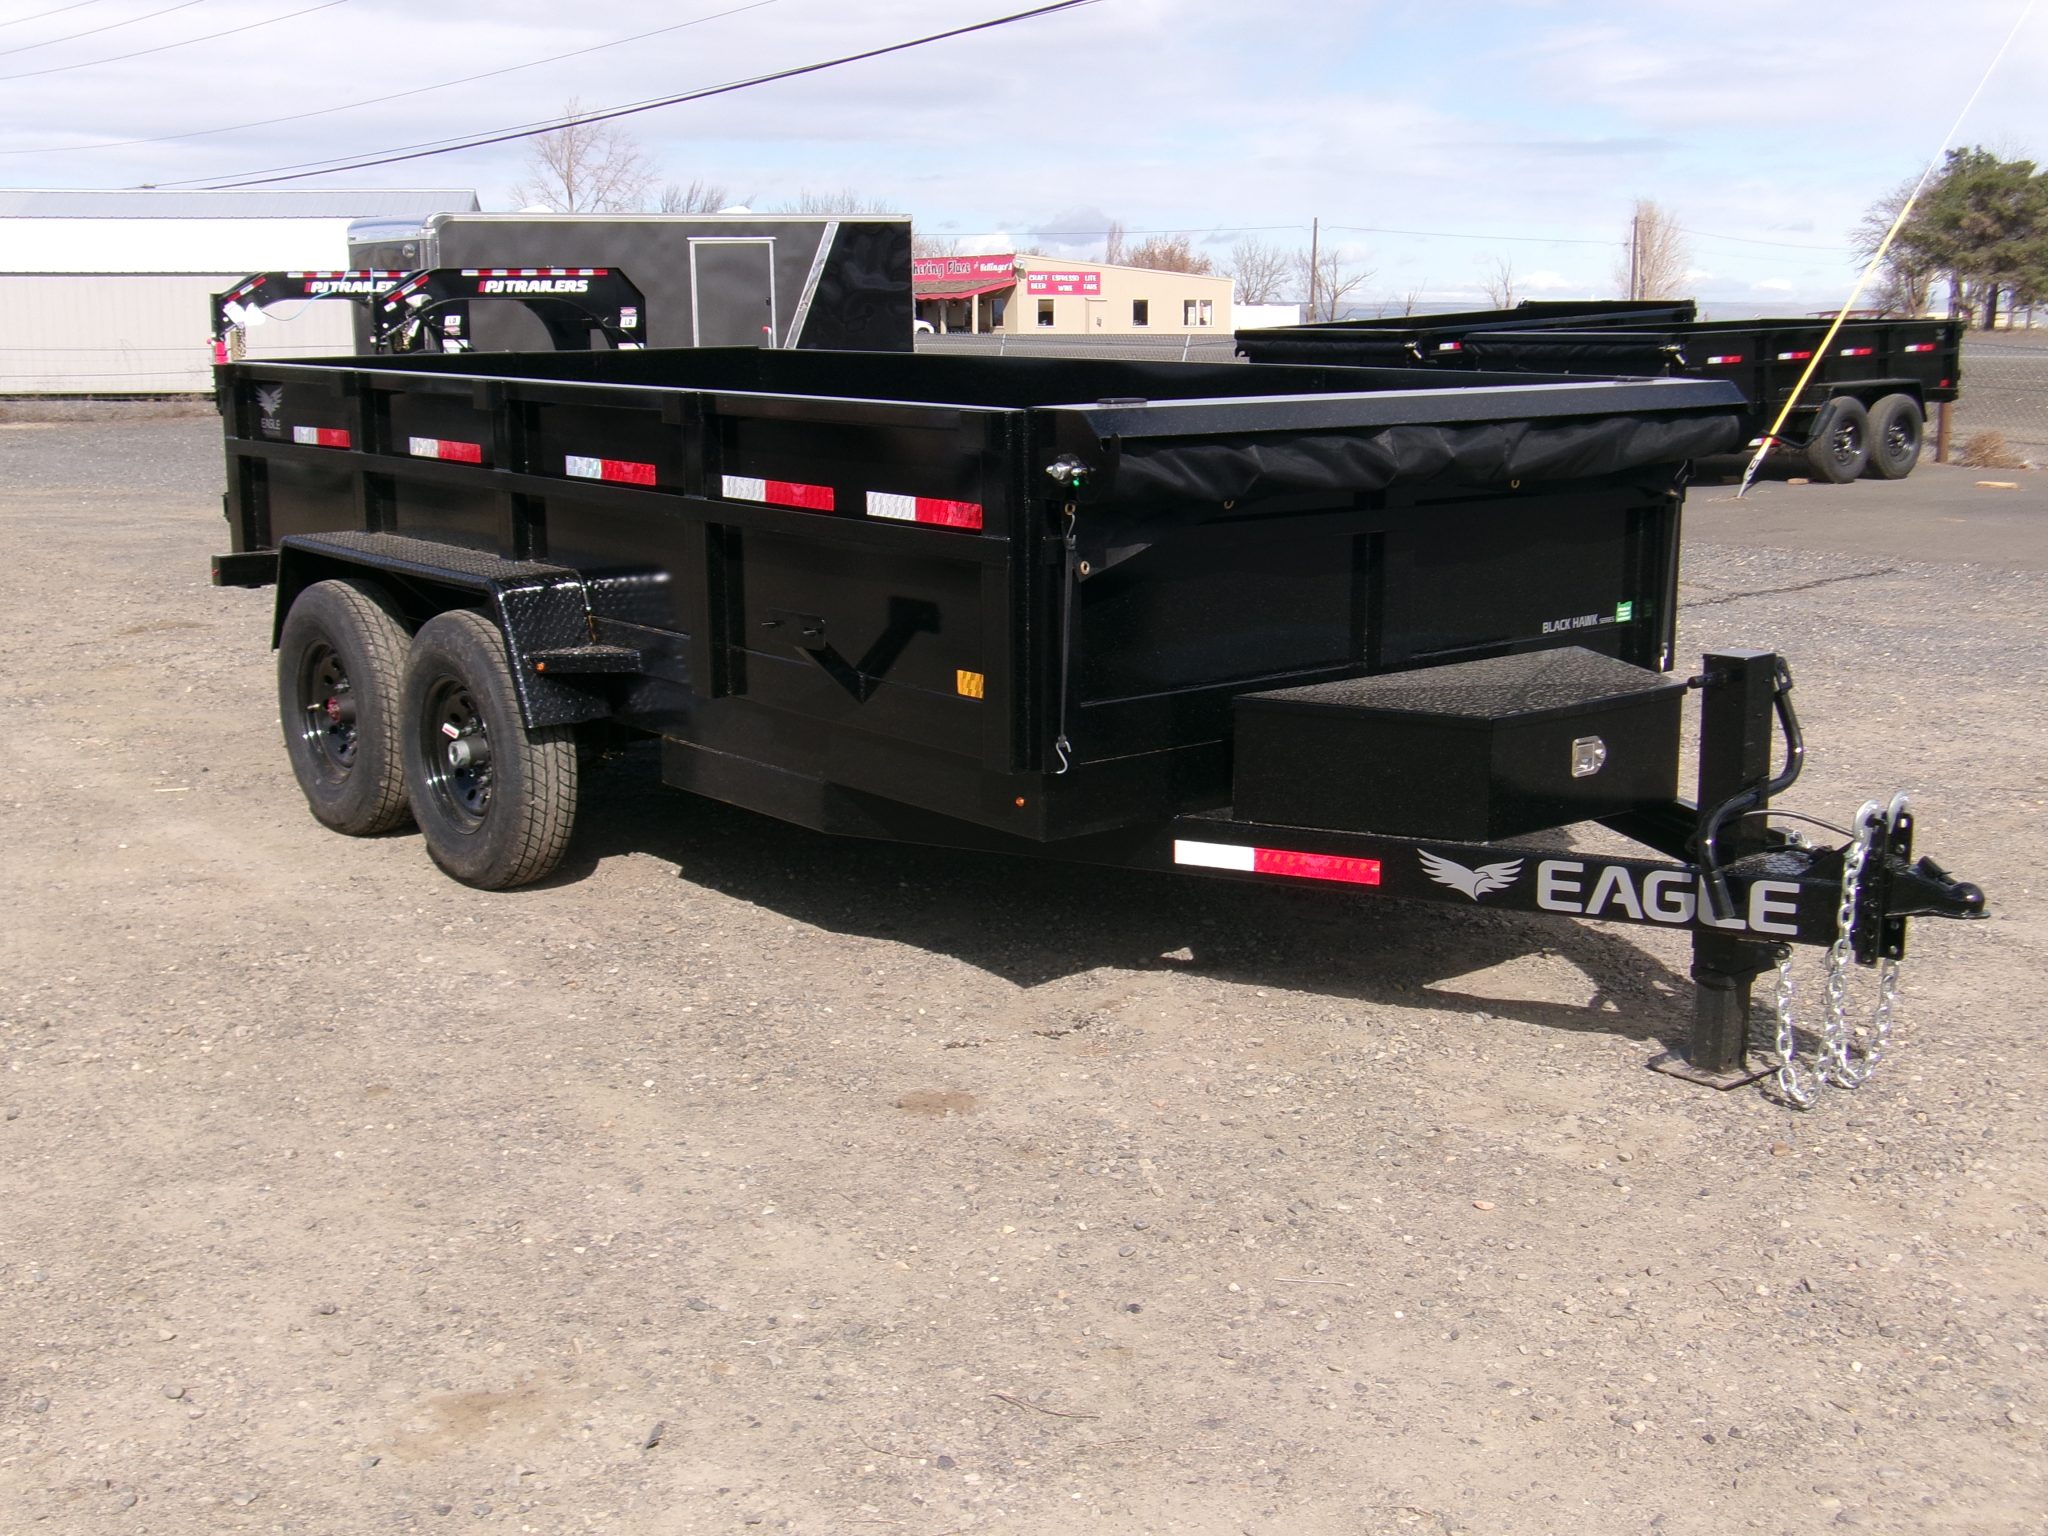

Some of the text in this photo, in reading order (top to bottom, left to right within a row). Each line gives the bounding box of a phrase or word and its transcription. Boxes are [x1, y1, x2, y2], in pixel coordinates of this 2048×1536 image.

[1051, 274, 1080, 282] ESPRESSO
[1084, 274, 1097, 282] LITE
[310, 281, 398, 293] PJ TRAILE
[484, 280, 589, 293] PJ TRAILERS
[1542, 618, 1571, 634] BLACK
[1572, 613, 1599, 629] HAWK
[1537, 859, 1801, 935] EAGLE
